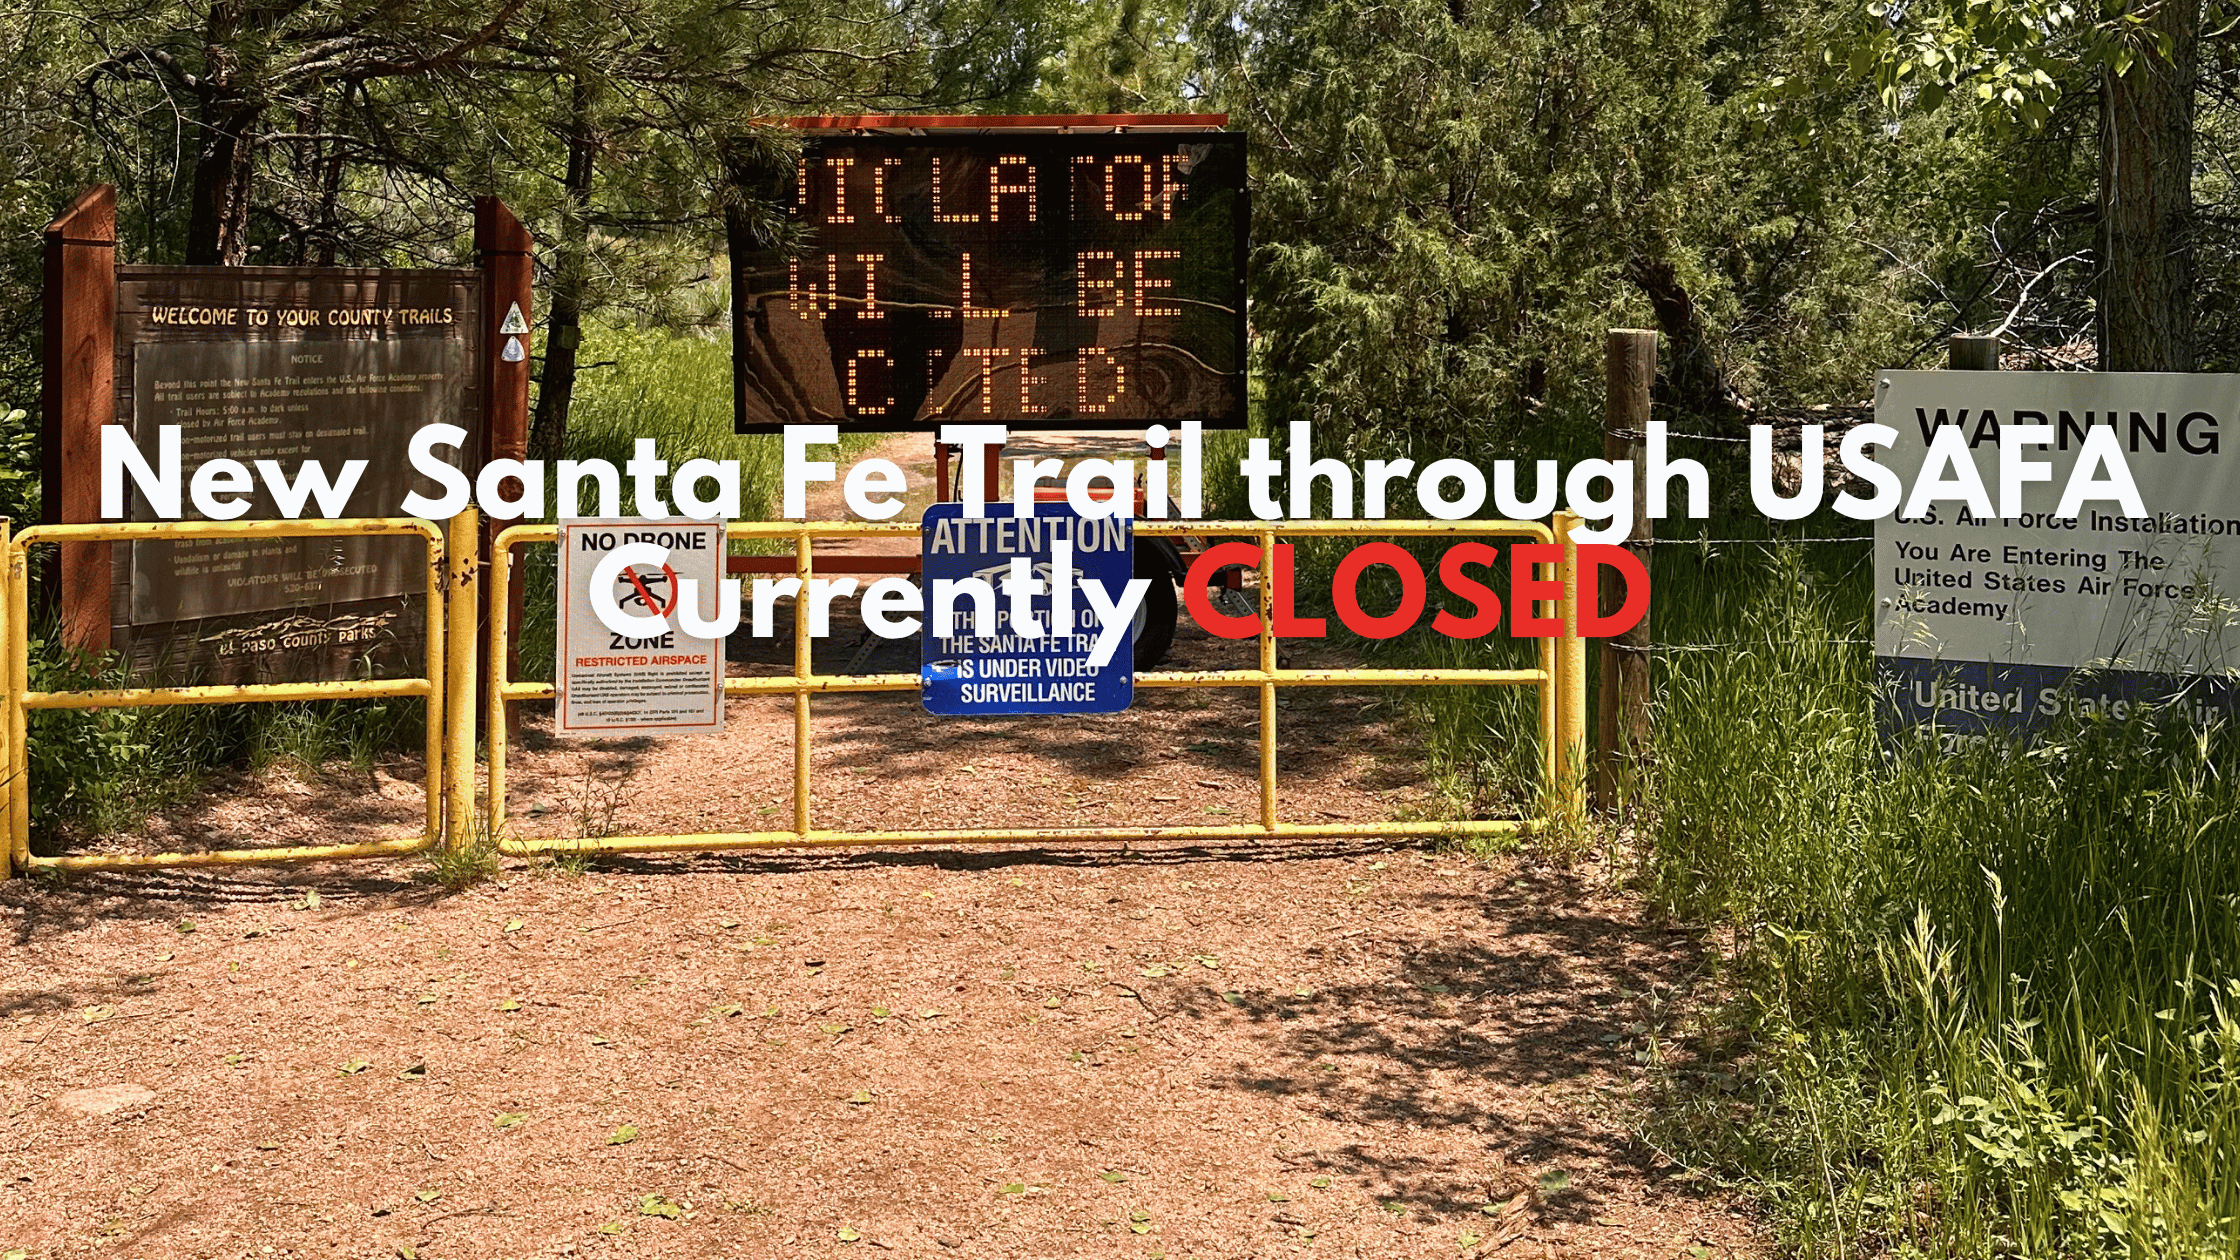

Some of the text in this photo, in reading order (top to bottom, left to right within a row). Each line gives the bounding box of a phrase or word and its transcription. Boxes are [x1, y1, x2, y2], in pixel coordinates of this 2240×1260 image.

[789, 250, 1182, 319] WIL BE
[151, 306, 453, 326] WELCOME TO YOUR COUNTY TRAILS
[291, 355, 324, 364] NOTICE
[154, 380, 181, 390] Beyond
[183, 380, 197, 388] this
[199, 379, 218, 389] point
[220, 379, 232, 387] the
[234, 378, 249, 387] New
[252, 377, 271, 386] Santa
[274, 377, 282, 385] Fe
[284, 376, 300, 385] Trail
[303, 376, 324, 385] enters
[326, 376, 337, 384] the
[339, 375, 354, 383] U.S.
[356, 374, 366, 382] Air
[369, 373, 386, 382] Force
[388, 373, 417, 382] Academy
[154, 392, 165, 402] All
[167, 392, 183, 401] trail
[186, 392, 206, 400] users
[208, 391, 220, 399] are
[222, 390, 247, 399] subject
[250, 390, 257, 398] to
[260, 389, 291, 398] Academy
[293, 387, 329, 397] regulations
[332, 386, 343, 394] and
[346, 386, 357, 394] the
[359, 385, 387, 394] following
[175, 407, 193, 417] Trail
[195, 406, 220, 415] Hours:
[222, 405, 239, 415] 5:00
[260, 405, 268, 413] to
[269, 404, 285, 413] dark
[287, 404, 309, 412] unless
[202, 420, 211, 428] by
[213, 418, 224, 427] Air
[227, 417, 246, 426] Force
[1914, 407, 2219, 455] WARNING
[181, 434, 228, 444] on-motorized
[230, 432, 244, 441] trail
[247, 432, 266, 440] users
[269, 431, 286, 440] must
[288, 431, 303, 439] stay
[305, 430, 314, 438] on
[316, 428, 350, 437] designated
[181, 445, 312, 460] on-motorized vehicles only except for
[2090, 509, 2240, 536] Installation
[582, 531, 707, 551] NO DRONE
[930, 517, 1126, 554] ATTENTION
[174, 553, 210, 564] Vandalism
[212, 552, 221, 561] or
[223, 550, 250, 560] damage
[261, 546, 282, 556] plants
[284, 545, 298, 554] and
[1895, 541, 2165, 573] You Are Entering The
[174, 566, 200, 576] wildlife
[202, 565, 209, 573] is
[227, 573, 279, 588] VIOLATORS
[281, 571, 303, 582] WILL
[306, 570, 318, 579] BE
[284, 582, 322, 594] 520-637
[1894, 567, 2195, 600] United States Air Force
[1895, 594, 2009, 621] Academy
[609, 631, 674, 650] ZONE
[939, 635, 974, 654] THE
[978, 634, 1035, 654] SANTA
[1040, 634, 1061, 653] FE
[575, 655, 707, 667] RESTRICTED AIRSPACE
[956, 657, 1100, 679] IS UNDER VIDEO
[961, 682, 1096, 704] SURVEILLANCE
[1915, 681, 2023, 713] United
[2038, 688, 2130, 721] State
